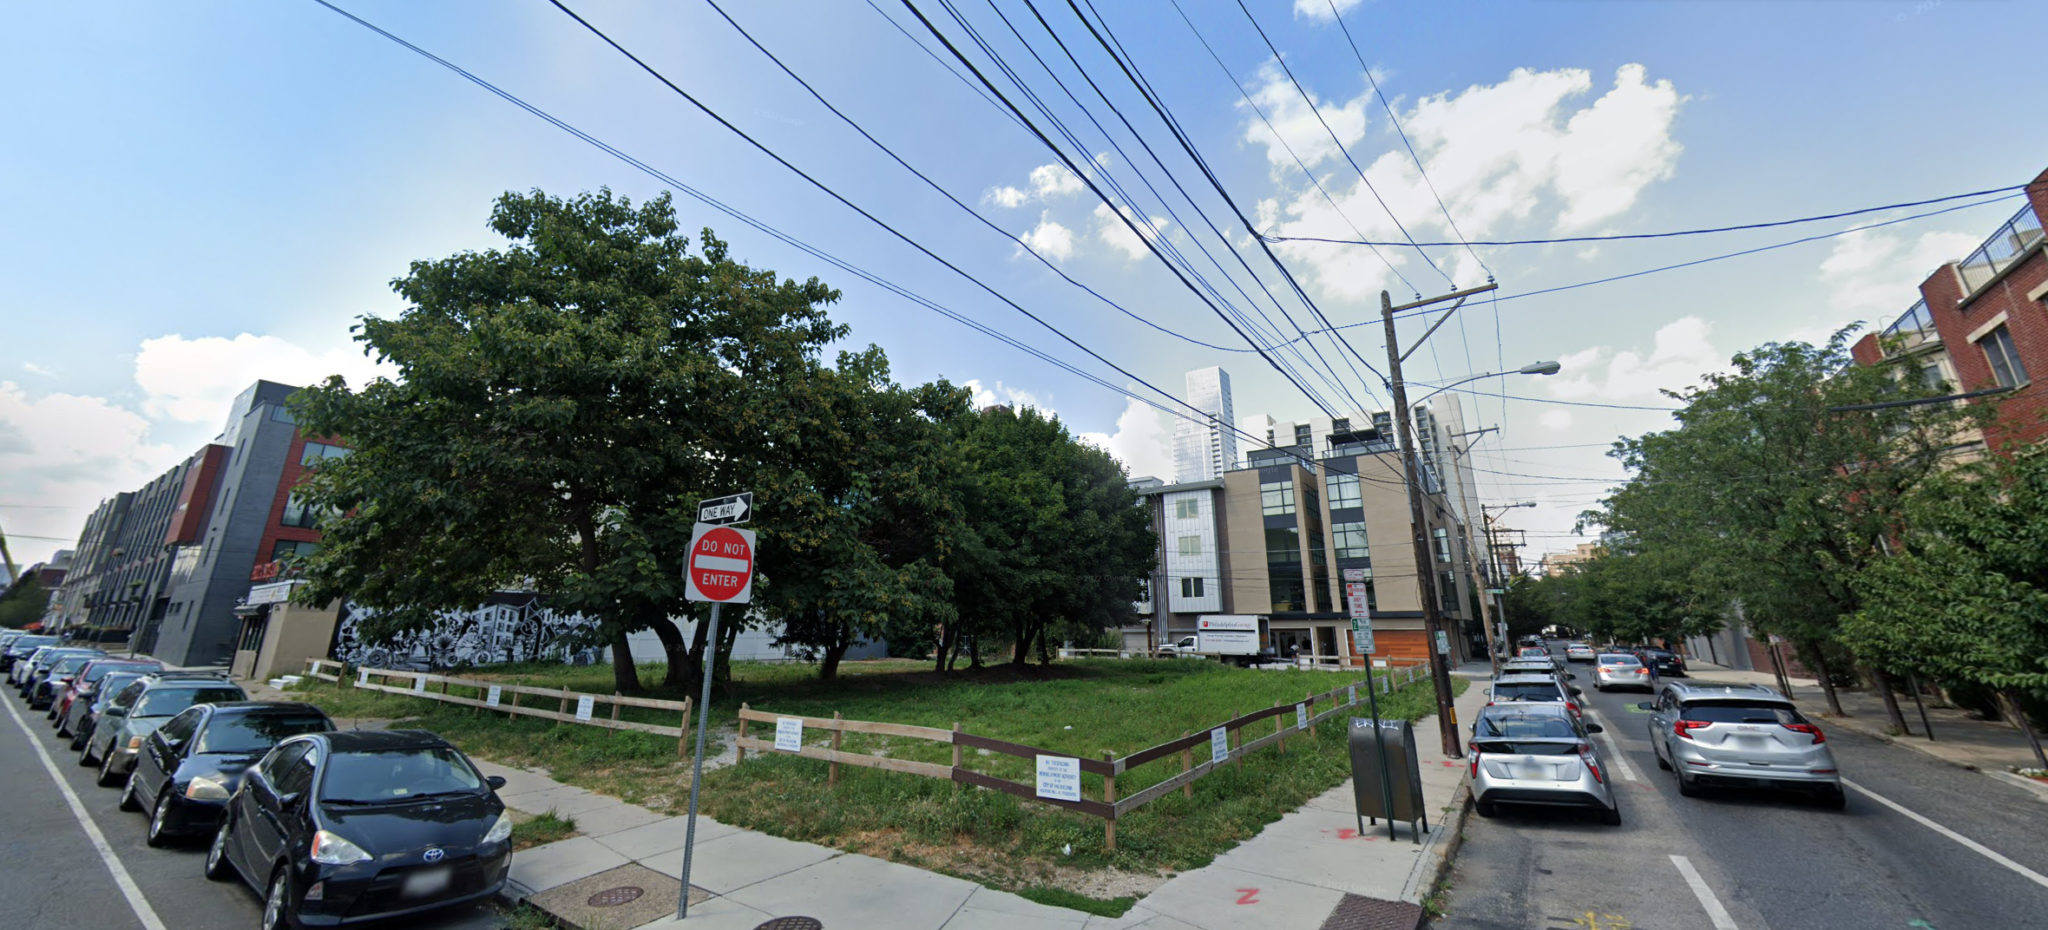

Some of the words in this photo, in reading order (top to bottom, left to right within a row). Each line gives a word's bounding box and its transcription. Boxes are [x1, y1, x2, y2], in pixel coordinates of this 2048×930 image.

[703, 507, 718, 520] ONE
[720, 504, 735, 516] WAY
[702, 540, 717, 552] DO
[724, 543, 745, 556] NOT
[702, 573, 737, 587] ENTER
